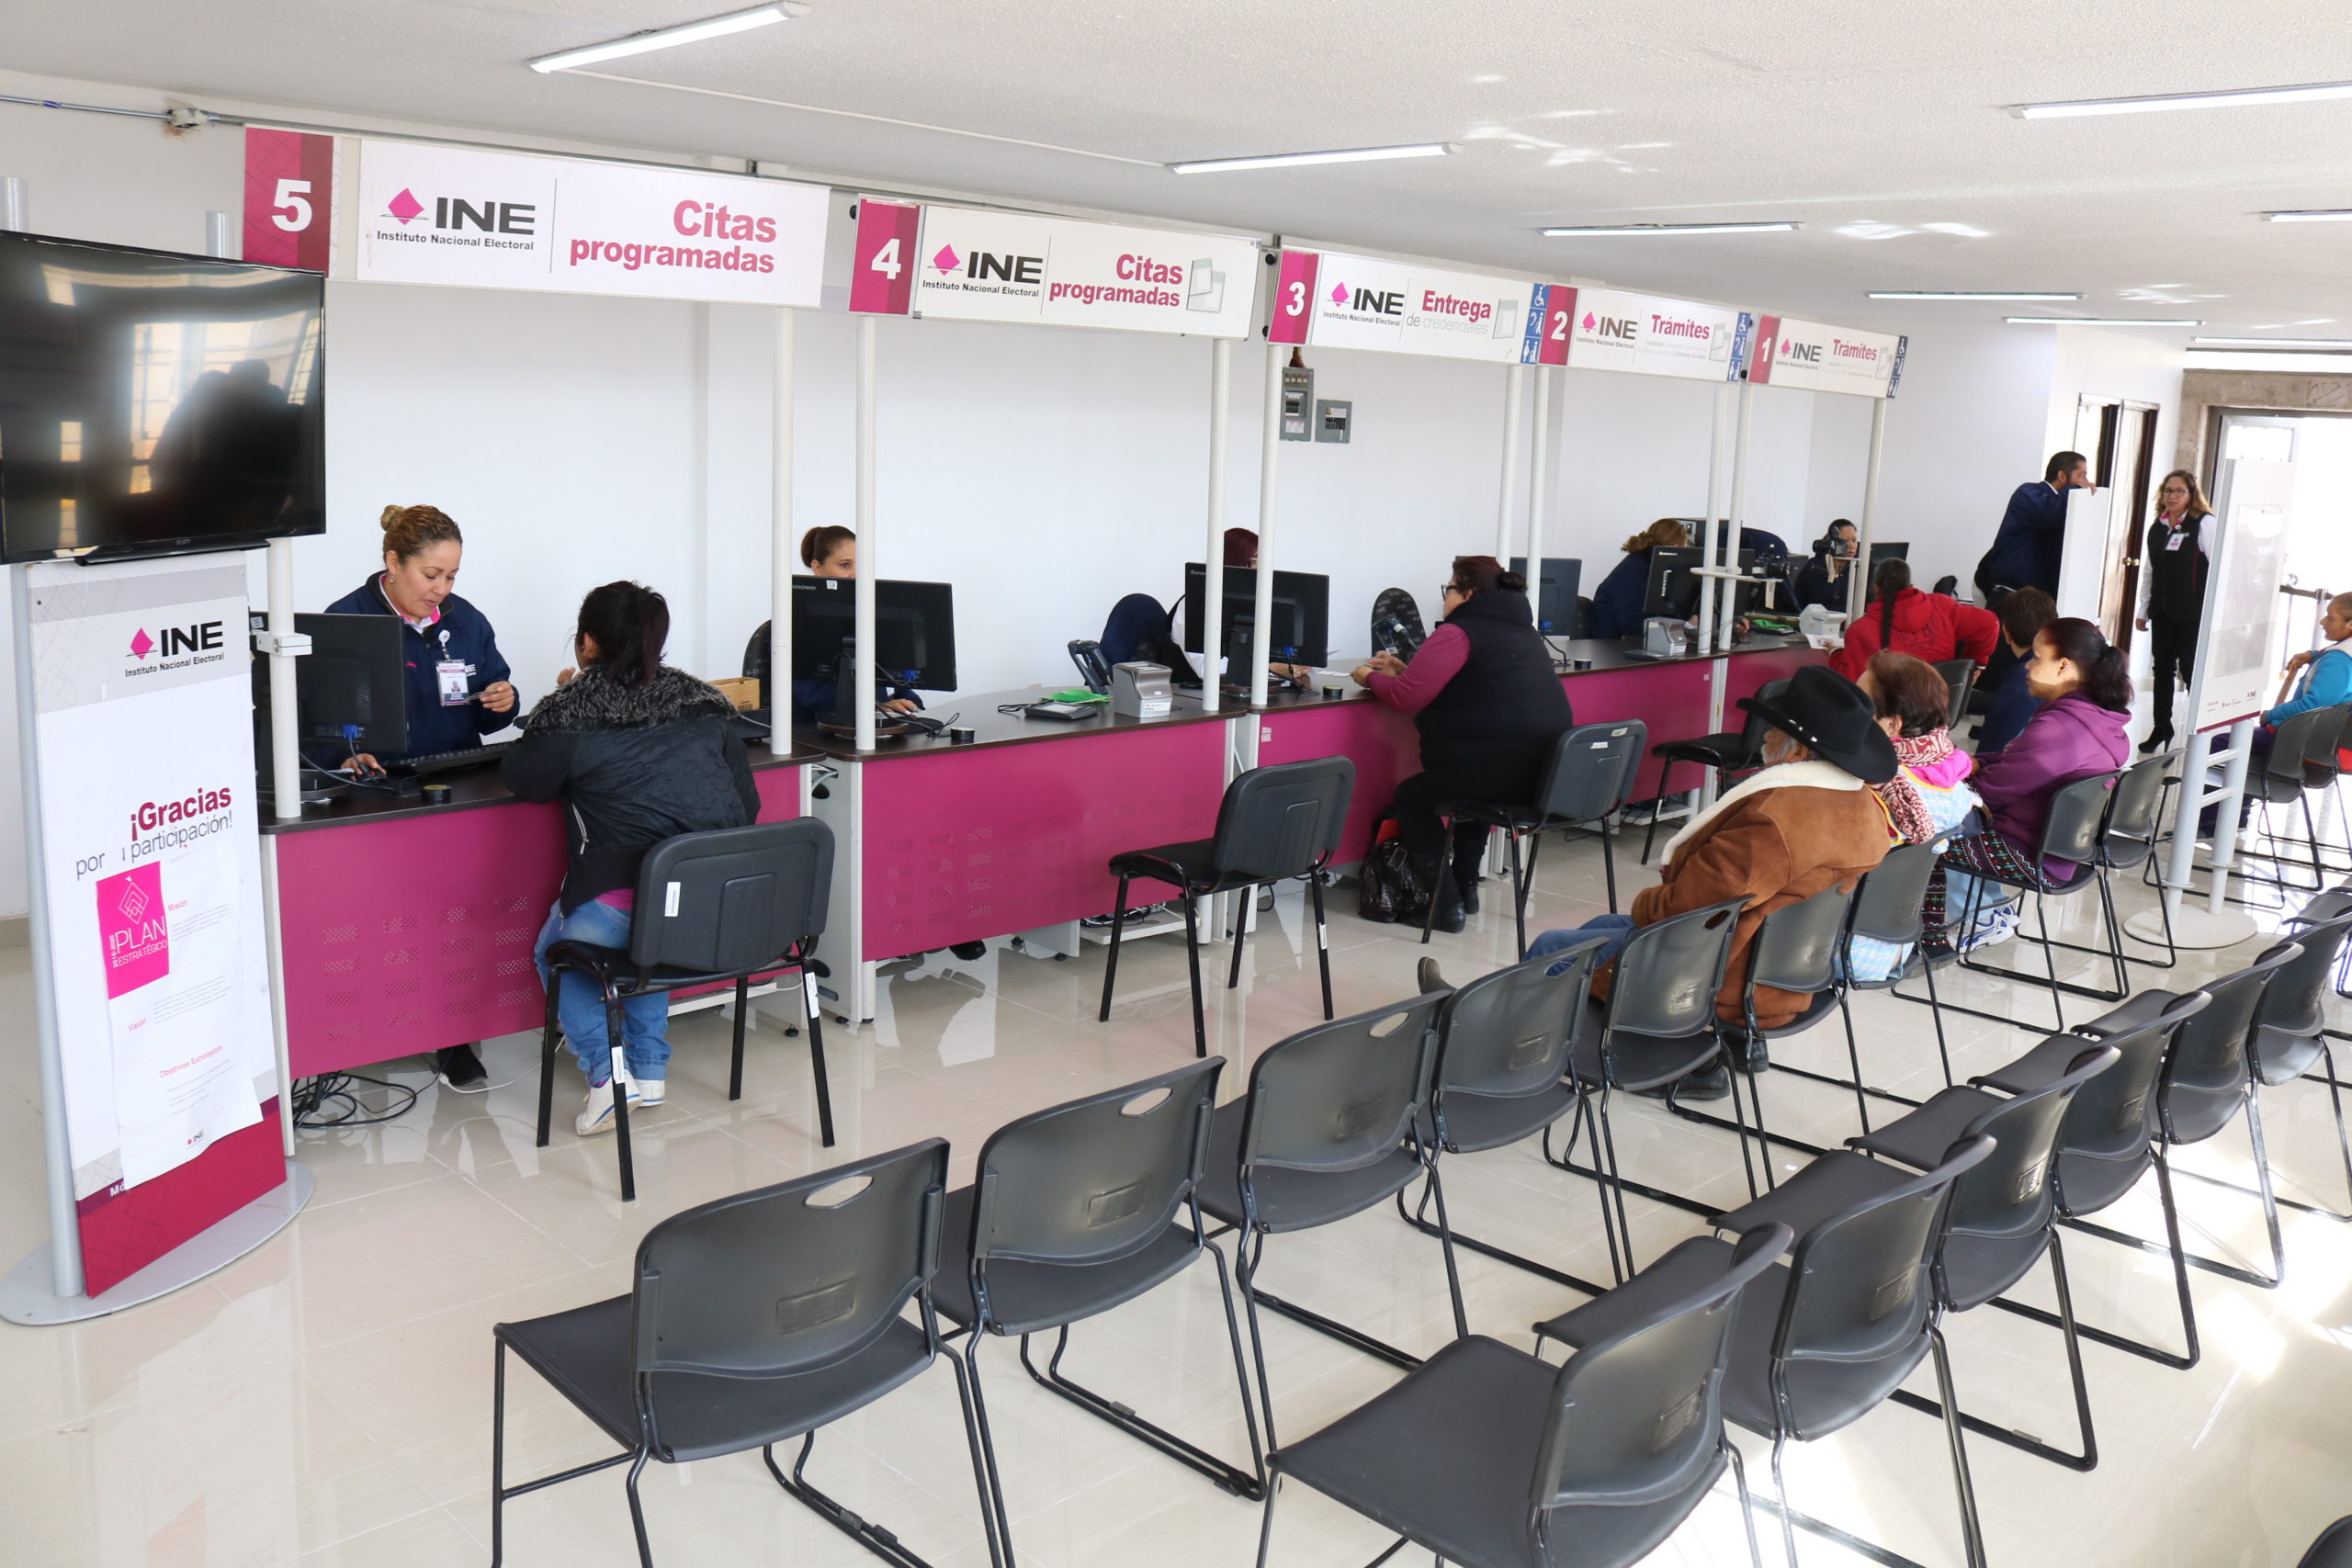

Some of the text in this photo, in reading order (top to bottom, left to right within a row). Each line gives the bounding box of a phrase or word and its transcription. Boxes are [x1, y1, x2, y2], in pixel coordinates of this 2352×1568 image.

[271, 178, 312, 231] 5
[435, 197, 536, 235] INE
[673, 199, 776, 243] Citas
[377, 230, 535, 251] Instituto Nacional Electoral
[570, 238, 775, 274] programadas
[871, 238, 901, 279] 4
[967, 251, 1044, 284] INE
[1115, 254, 1183, 285] Citas
[922, 279, 1039, 298] Instituto Nacional Electoral
[1049, 281, 1181, 307] programadas
[1286, 281, 1306, 316] 3
[1352, 288, 1405, 316] INE
[1323, 310, 1401, 326] Instituto Nacional Electoral
[1422, 289, 1492, 322] Entrega
[1407, 312, 1488, 335] de credenciales
[1551, 310, 1568, 341] 2
[1599, 316, 1638, 341] INE
[1651, 314, 1710, 340] Trámites
[1762, 337, 1771, 363] 1
[1792, 343, 1823, 362] INE
[1833, 338, 1877, 361] Trámites
[160, 620, 223, 658] INE
[125, 652, 224, 678] Instituto Nacional Electoral
[130, 787, 232, 841] ¡Gracias
[76, 810, 233, 880] por participación!
[115, 916, 166, 954] PLAN
